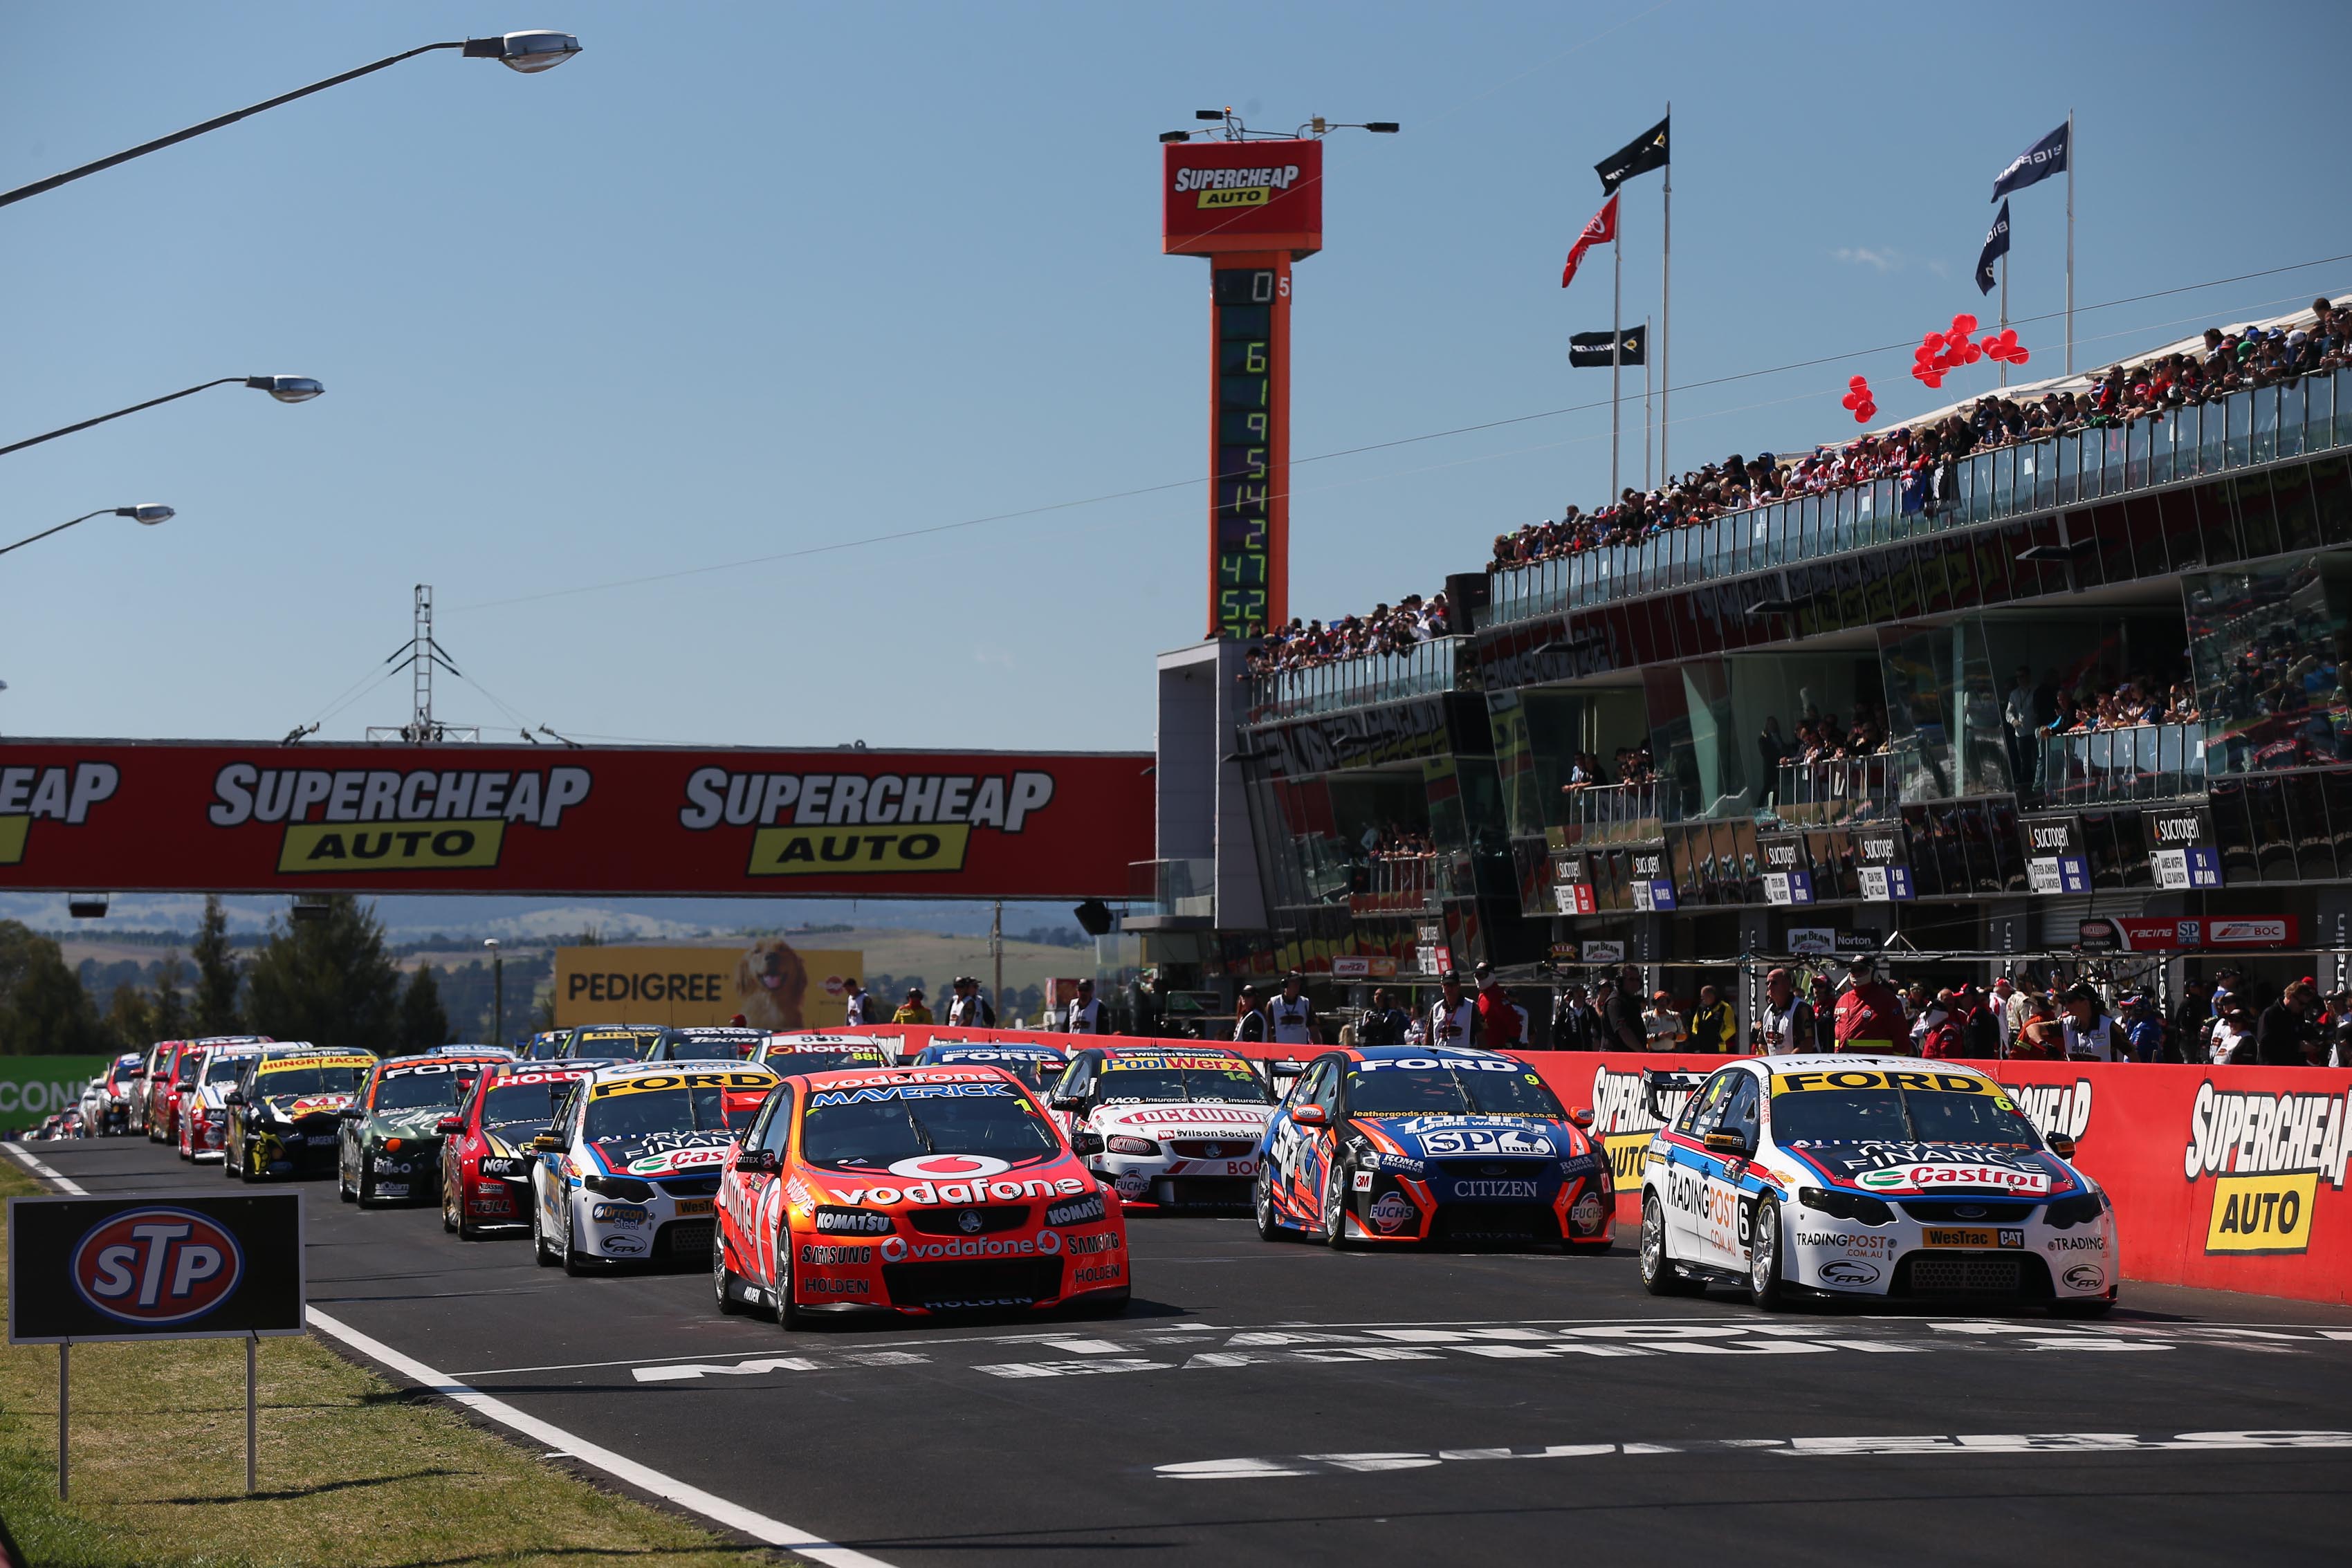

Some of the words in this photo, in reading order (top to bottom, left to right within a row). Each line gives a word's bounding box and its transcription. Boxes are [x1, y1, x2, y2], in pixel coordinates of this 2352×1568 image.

[1175, 165, 1298, 192] SUPERCHEAP
[1206, 190, 1261, 204] AUTO
[1252, 272, 1273, 302] 0
[1279, 277, 1289, 297] 5
[1247, 342, 1265, 372] 6
[1260, 378, 1267, 406] 1
[1247, 413, 1267, 441] 9
[1247, 448, 1265, 479] 5
[1235, 485, 1266, 513] 14
[1245, 519, 1265, 549] 2
[1222, 554, 1265, 583] 47
[1222, 589, 1265, 620] 52
[208, 762, 593, 829] SUPERCHEAP
[679, 765, 1056, 832] SUPERCHEAP
[2034, 826, 2068, 854] sucrogen
[2159, 818, 2200, 847] sucrogen
[306, 829, 476, 861] AUTO
[776, 833, 941, 863] AUTO
[2179, 922, 2198, 936] SP
[2254, 926, 2280, 936] BOC
[1792, 934, 1808, 947] JIM
[1808, 931, 1830, 947] BEAM
[1837, 936, 1871, 946] Norton
[1600, 941, 1619, 957] BEAM
[568, 974, 722, 1002] PEDIGREE
[795, 1044, 879, 1054] Norton
[941, 1052, 1060, 1062] FORD
[1134, 1051, 1176, 1059] Wilson
[263, 1057, 322, 1070] HUNGRY
[327, 1055, 374, 1064] JACK'S
[1107, 1058, 1246, 1071] PoolWerx
[1360, 1058, 1519, 1072] FORD
[594, 1073, 780, 1098] FORD
[814, 1072, 1004, 1091] vodafone
[1223, 1071, 1253, 1082] 14
[1523, 1073, 1539, 1086] 9
[1783, 1071, 1985, 1091] FORD
[811, 1083, 1018, 1108] MAVERICK
[1993, 1096, 2014, 1112] 6
[1177, 1129, 1219, 1138] Wilson
[1428, 1132, 1499, 1153] SP
[1110, 1139, 1148, 1152] LOCKWOOD
[484, 1159, 513, 1173] NGK
[1384, 1154, 1424, 1169] ROMA
[1559, 1156, 1592, 1170] ROMA
[1843, 1150, 2045, 1172] FINANCE
[1115, 1180, 1150, 1192] FUCHS
[1356, 1175, 1369, 1188] 3M
[1909, 1166, 2044, 1188] Castrol
[829, 1178, 1086, 1206] vodafone
[1455, 1181, 1538, 1197] CITIZEN
[470, 1200, 511, 1213] TOLL
[1666, 1170, 1736, 1230] TRADINGPOST
[604, 1205, 644, 1219] Orrcon
[1370, 1206, 1414, 1220] FUCHS
[1572, 1204, 1604, 1219] FUCHS
[2219, 1190, 2301, 1235] AUTO
[614, 1219, 638, 1230] Steel
[816, 1212, 890, 1232] KOMATSU
[1738, 1201, 1750, 1241] 6
[1797, 1233, 1886, 1249] TRADINGPOST
[1930, 1230, 1988, 1244] WesTrac
[2000, 1231, 2023, 1246] CAT
[2055, 1236, 2109, 1251] TRADING
[801, 1244, 872, 1265] SAMSUNG
[912, 1237, 1034, 1258] vodafone
[1845, 1249, 1883, 1259] .COM.AU
[93, 1222, 225, 1308] STP
[1074, 1264, 1120, 1284] HOLDEN
[804, 1278, 870, 1295] HOLDEN
[924, 1297, 1033, 1309] HOLDEN
